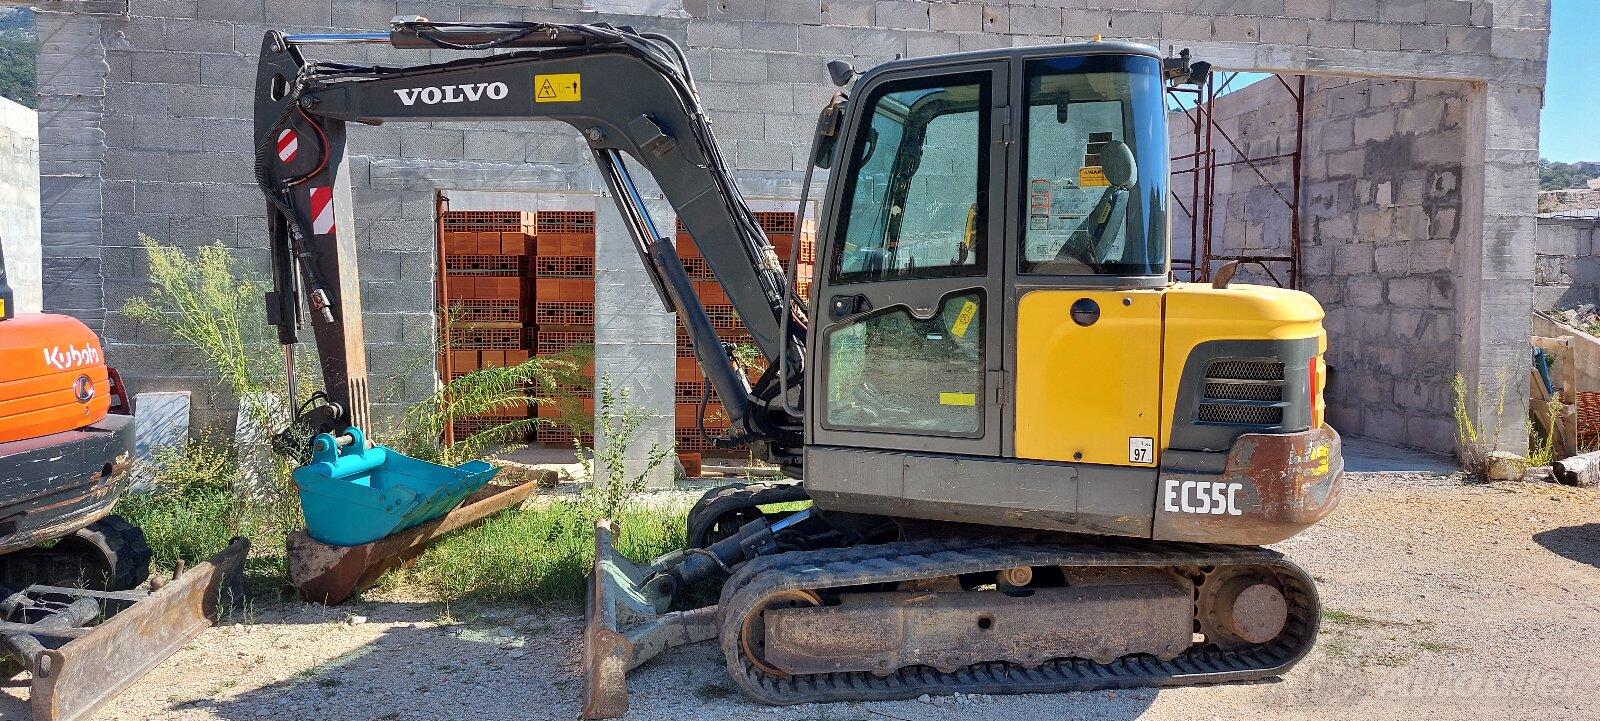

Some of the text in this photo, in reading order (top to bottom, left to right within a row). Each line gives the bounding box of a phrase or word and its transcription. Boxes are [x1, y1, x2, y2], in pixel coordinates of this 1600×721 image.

[393, 82, 509, 106] VOLVO
[43, 342, 100, 369] Kubota
[1134, 448, 1147, 461] 97
[1164, 479, 1243, 516] EC55C
